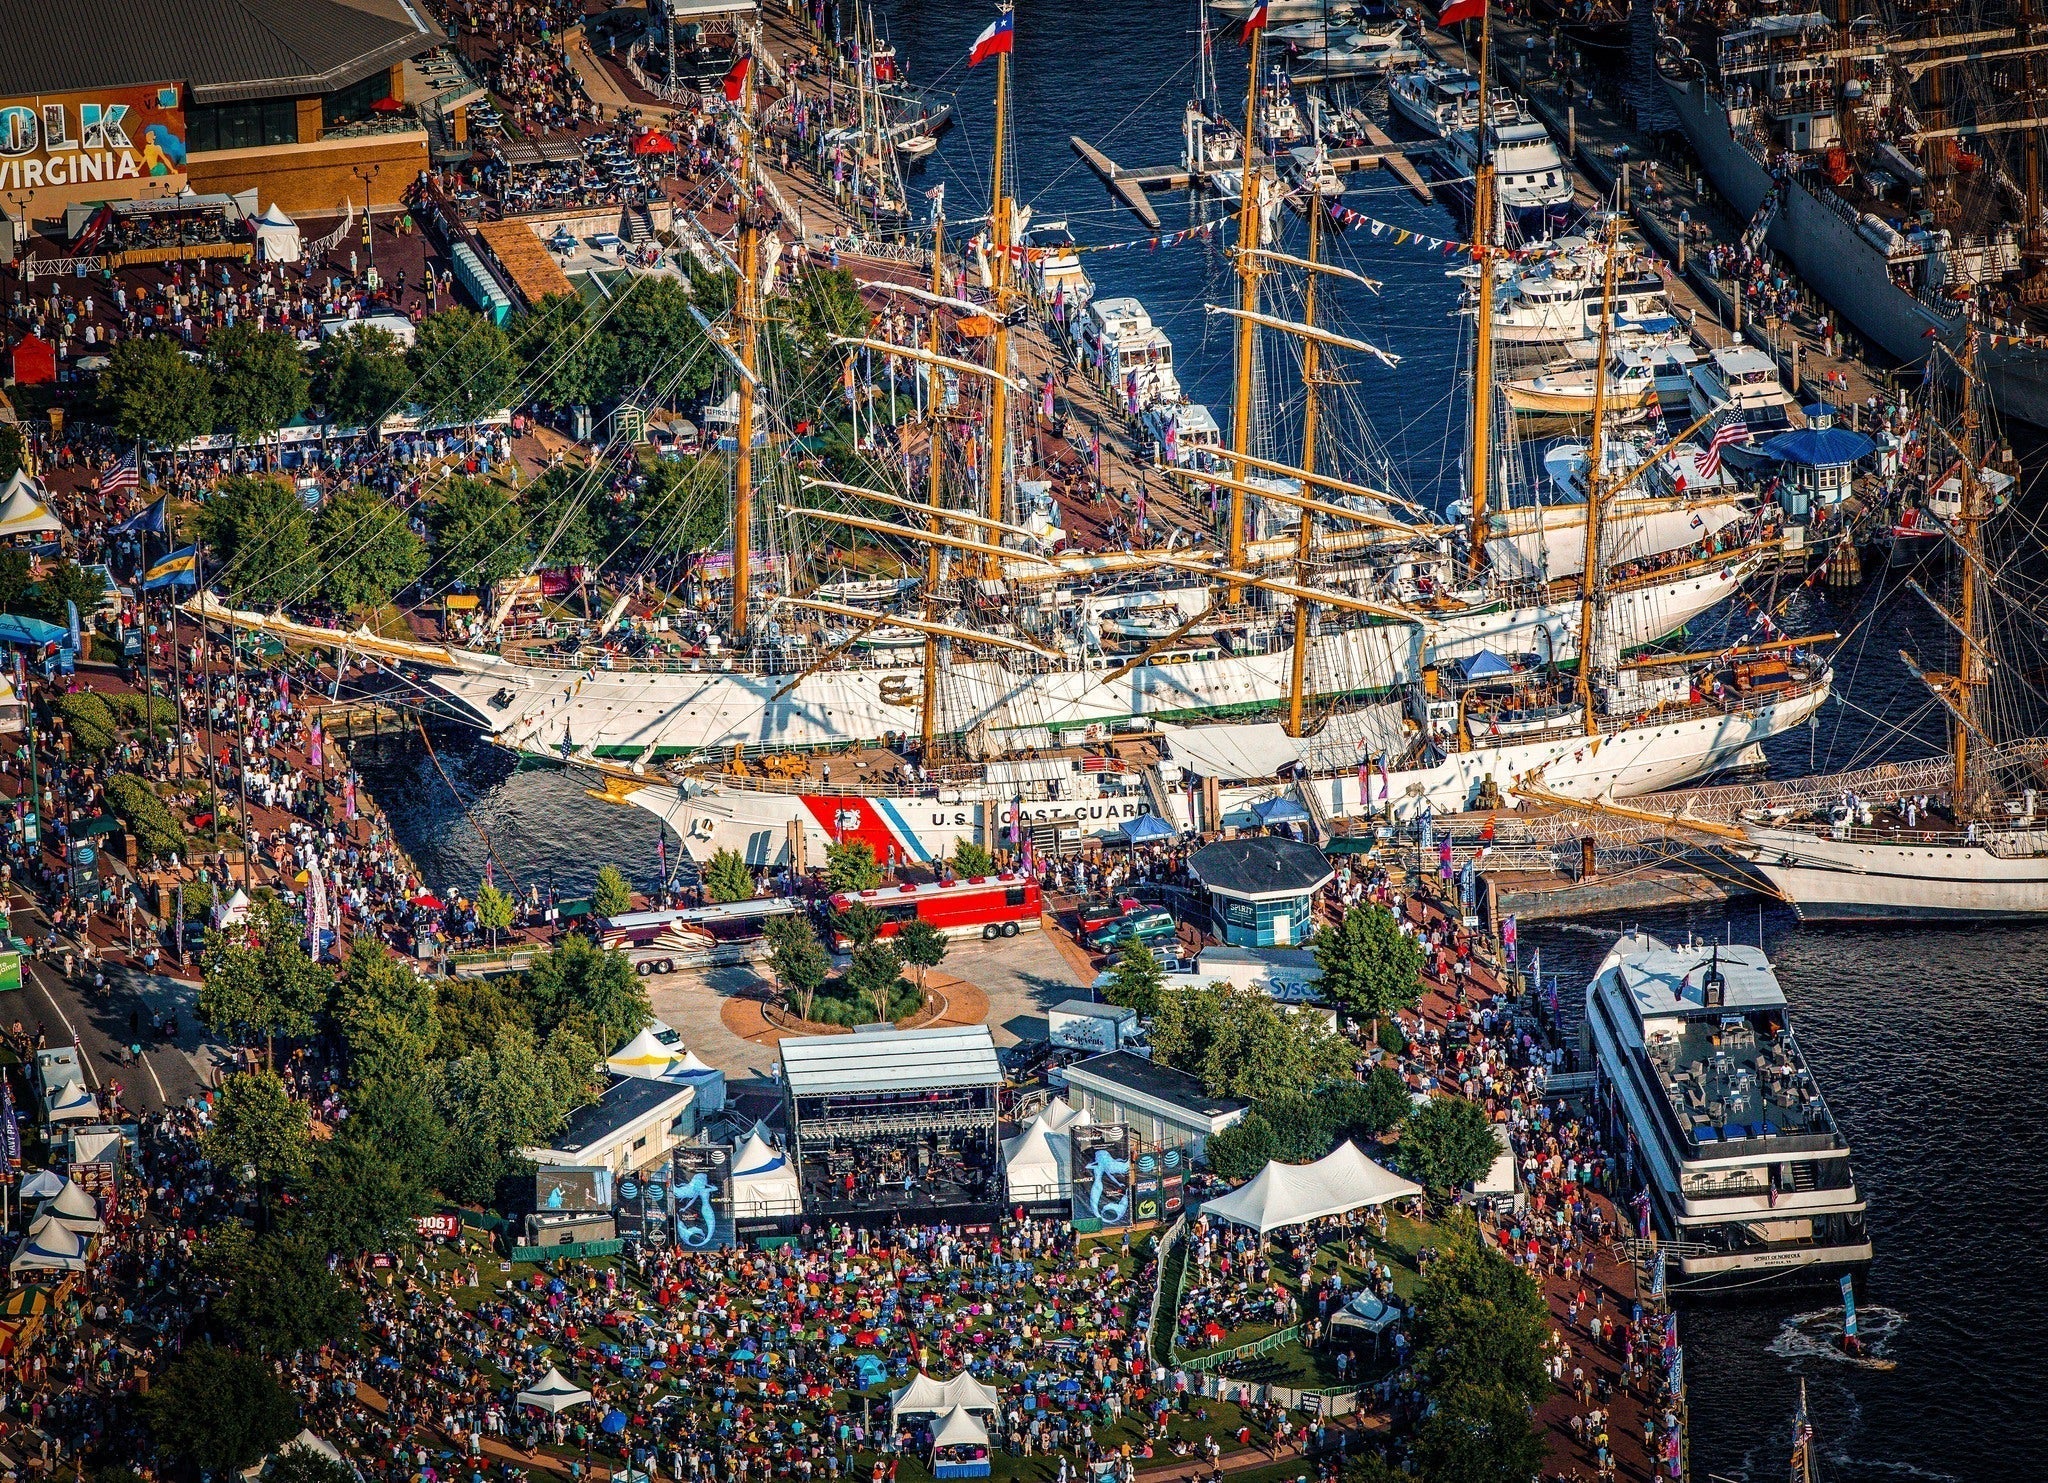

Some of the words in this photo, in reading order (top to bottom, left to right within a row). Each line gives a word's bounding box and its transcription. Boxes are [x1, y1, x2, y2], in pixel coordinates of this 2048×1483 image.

[362, 217, 371, 244] ATM
[425, 270, 434, 300] ATM
[712, 408, 728, 416] FIRST
[0, 622, 31, 633] GEICO
[1075, 803, 1151, 820] GUARD
[1230, 904, 1254, 914] SPIRIT
[7, 1136, 15, 1156] NAVY
